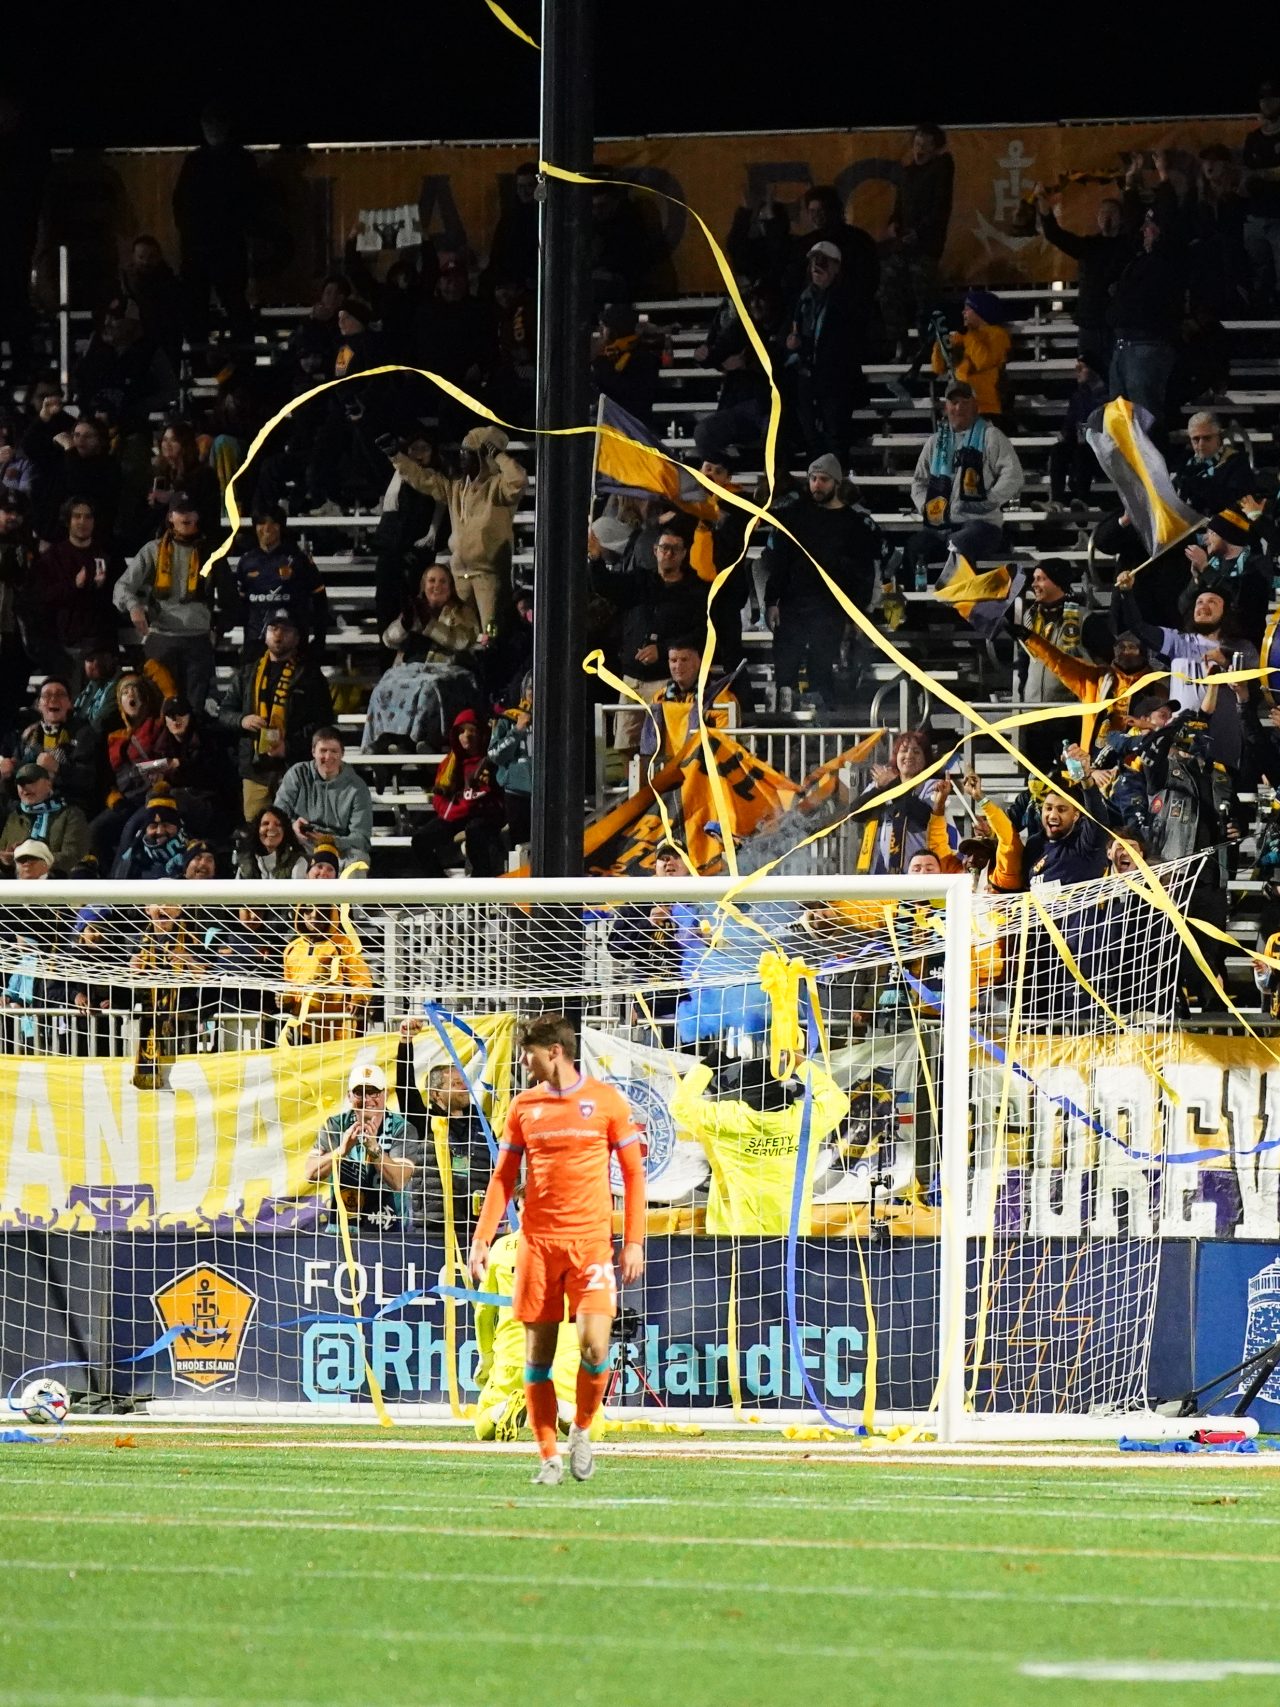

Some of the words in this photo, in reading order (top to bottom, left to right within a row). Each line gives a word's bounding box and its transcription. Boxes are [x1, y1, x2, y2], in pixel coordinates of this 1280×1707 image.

[748, 1135, 794, 1149] SAFETY
[176, 1360, 205, 1371] RHODE
[206, 1361, 235, 1372] ISLAND
